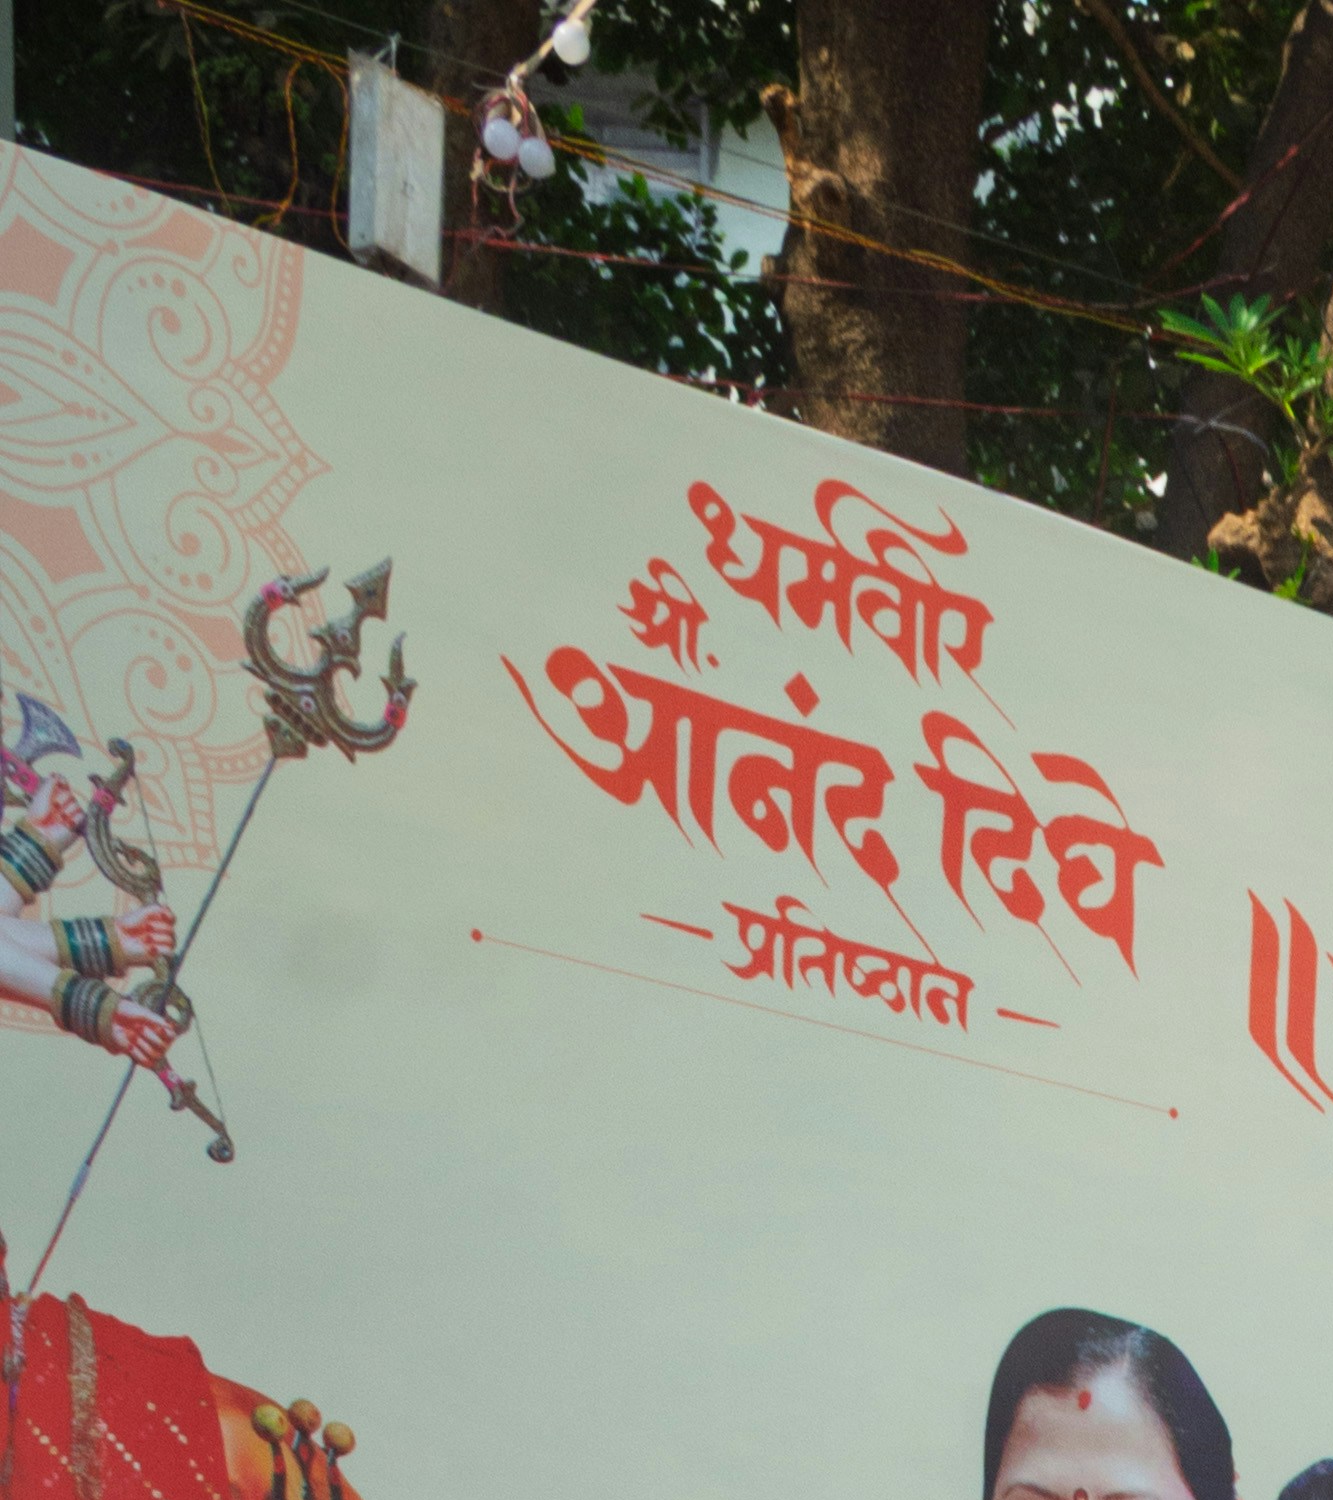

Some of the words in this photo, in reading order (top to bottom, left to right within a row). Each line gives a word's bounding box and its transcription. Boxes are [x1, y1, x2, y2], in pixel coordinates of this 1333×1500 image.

[617, 557, 720, 673] श्री.
[688, 479, 1000, 700] धर्मवीर
[500, 646, 900, 925] आनंद
[912, 710, 1165, 980] दिघे
[720, 895, 976, 1032] प्रतिष्ठान
